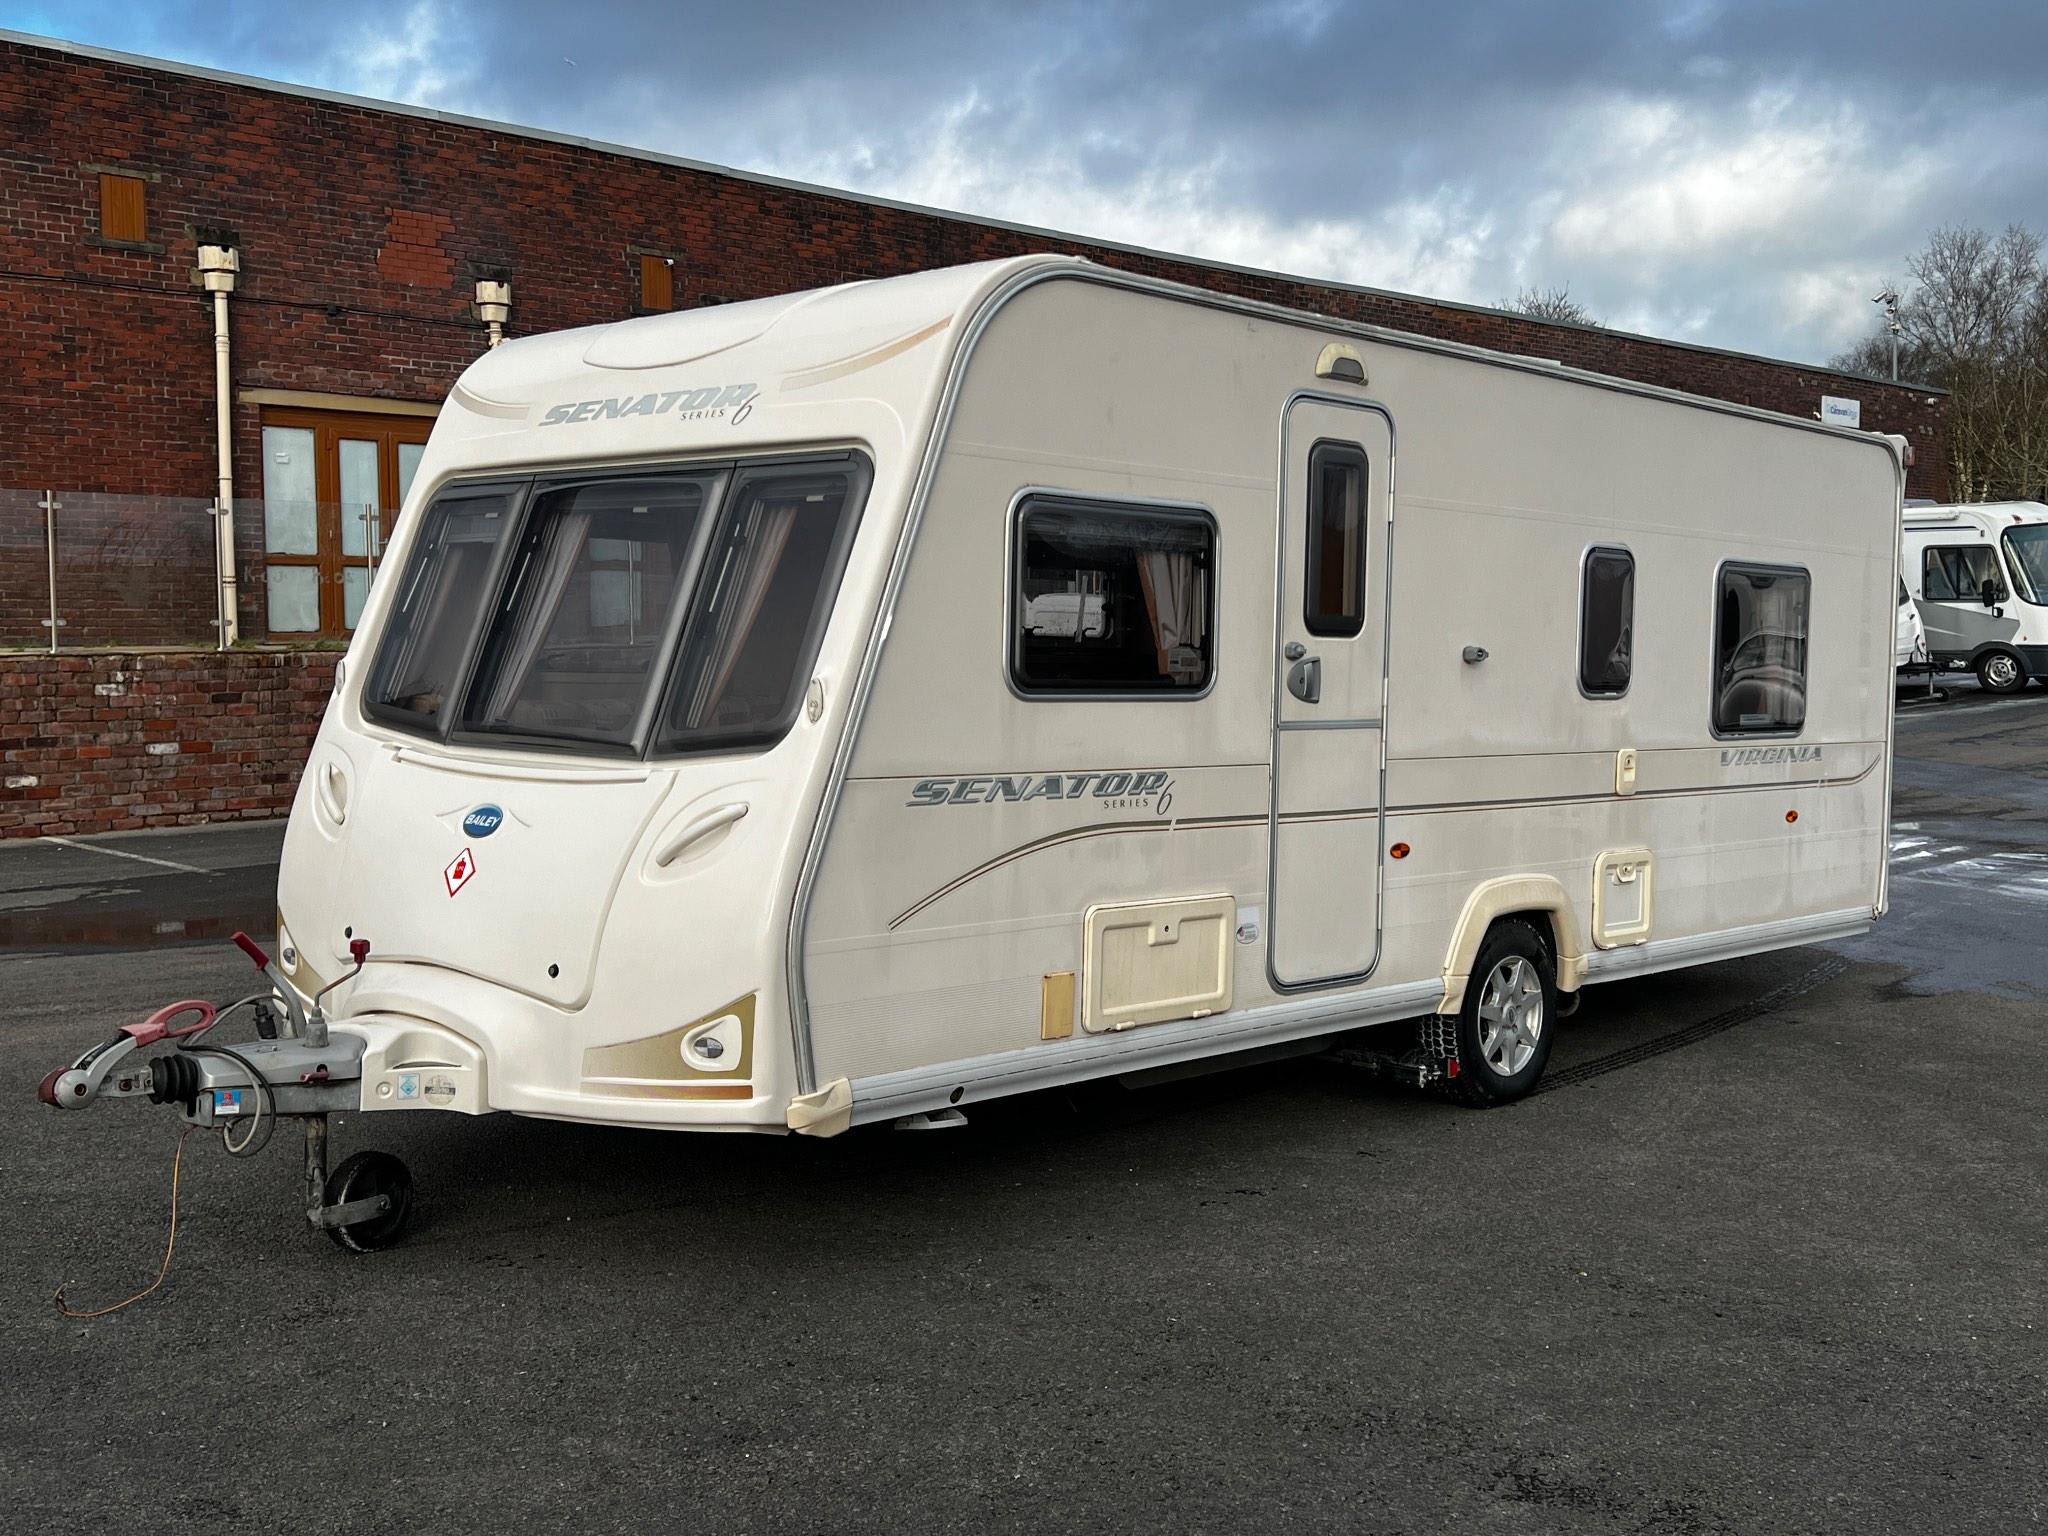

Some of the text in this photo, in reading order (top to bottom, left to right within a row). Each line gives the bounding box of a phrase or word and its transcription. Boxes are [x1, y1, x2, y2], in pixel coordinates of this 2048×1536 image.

[538, 383, 758, 427] SENATOR
[680, 392, 761, 426] SERIES 6
[1720, 747, 1823, 766] VIRGINIA
[905, 771, 1169, 808] SENATOR
[1103, 780, 1176, 816] SERIES 6
[464, 814, 500, 828] BAILEY
